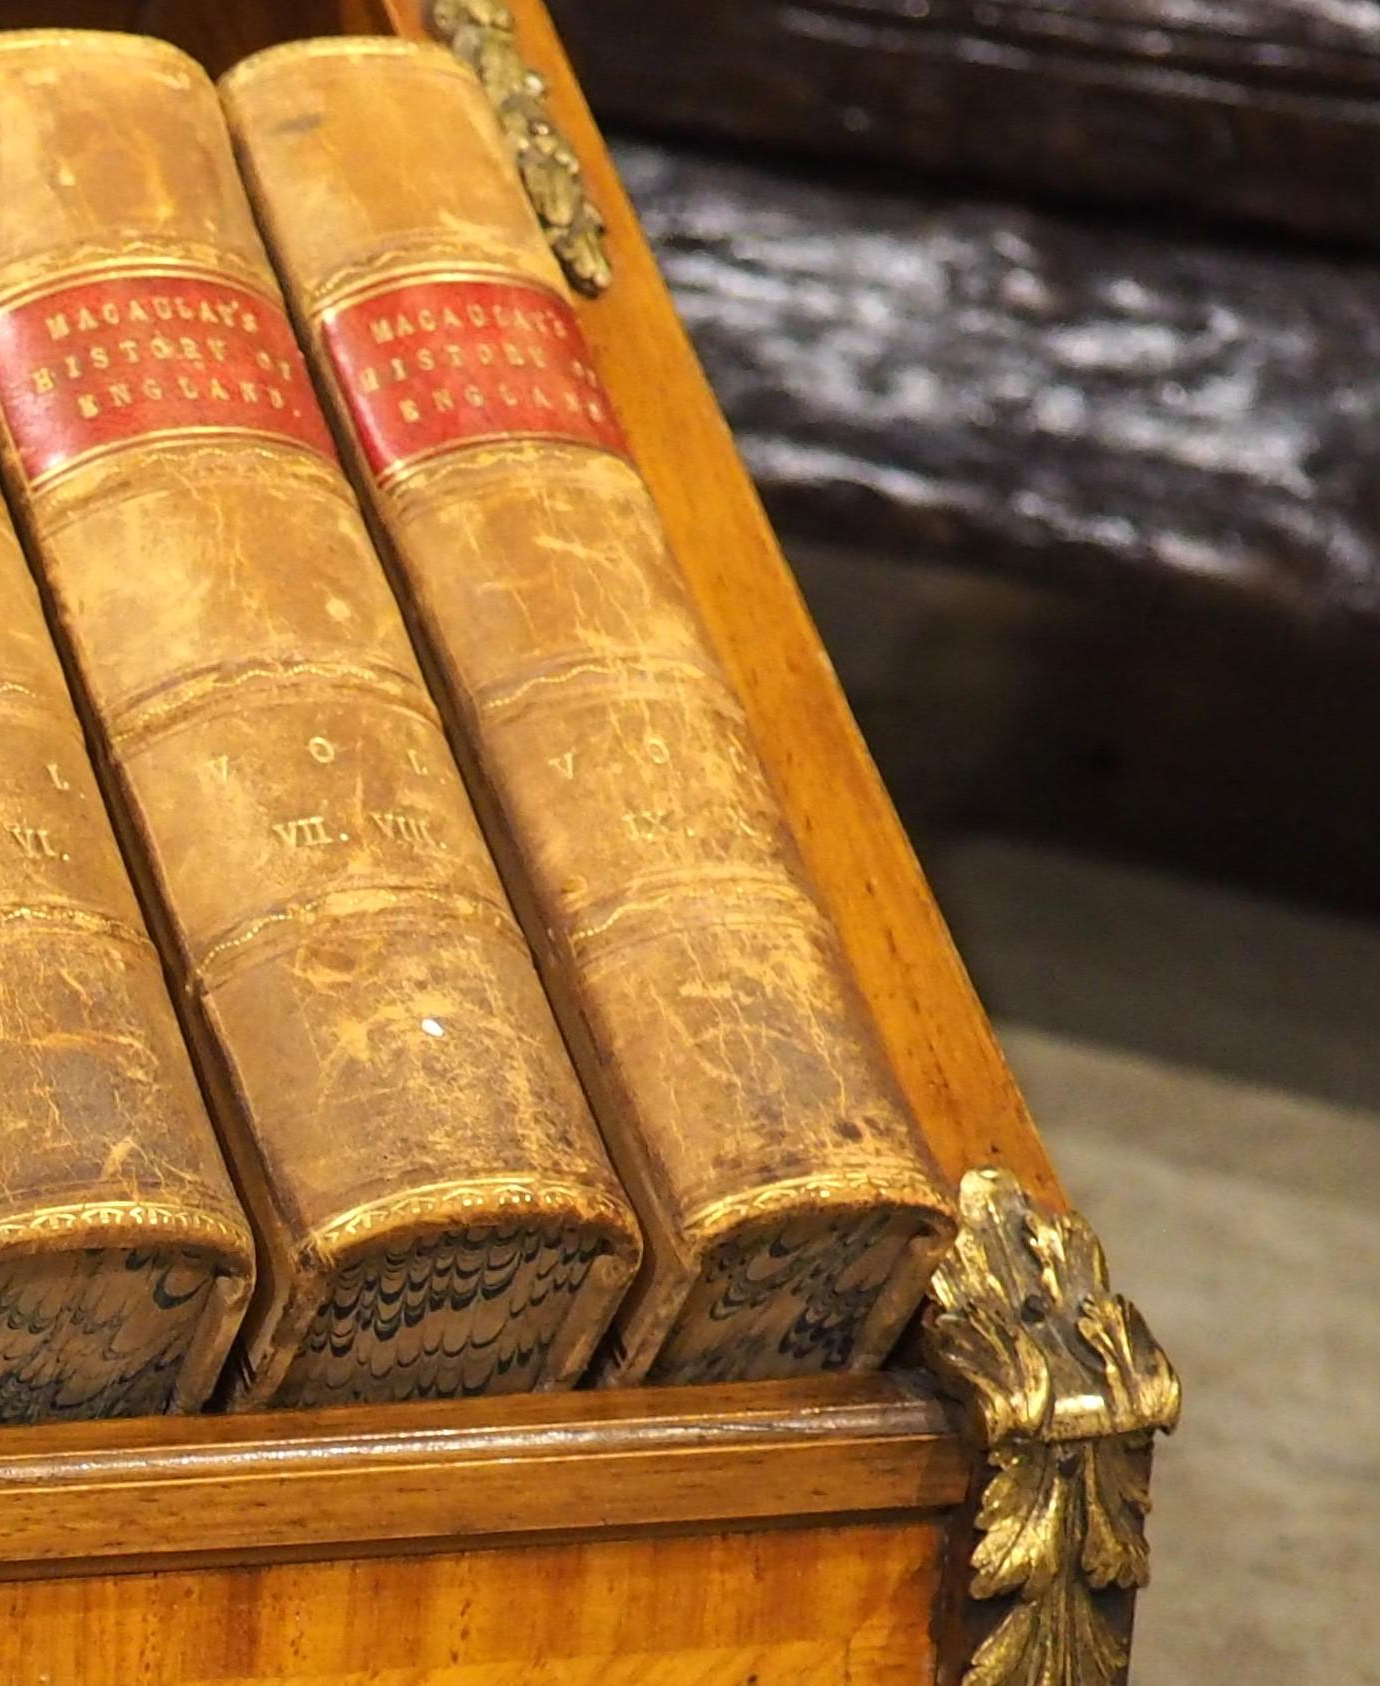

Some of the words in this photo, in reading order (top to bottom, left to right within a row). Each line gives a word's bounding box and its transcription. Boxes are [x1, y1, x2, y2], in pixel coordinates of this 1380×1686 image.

[45, 296, 258, 340] MACAULAY'S
[32, 335, 225, 394] HISTORY
[271, 815, 350, 848] VII.
